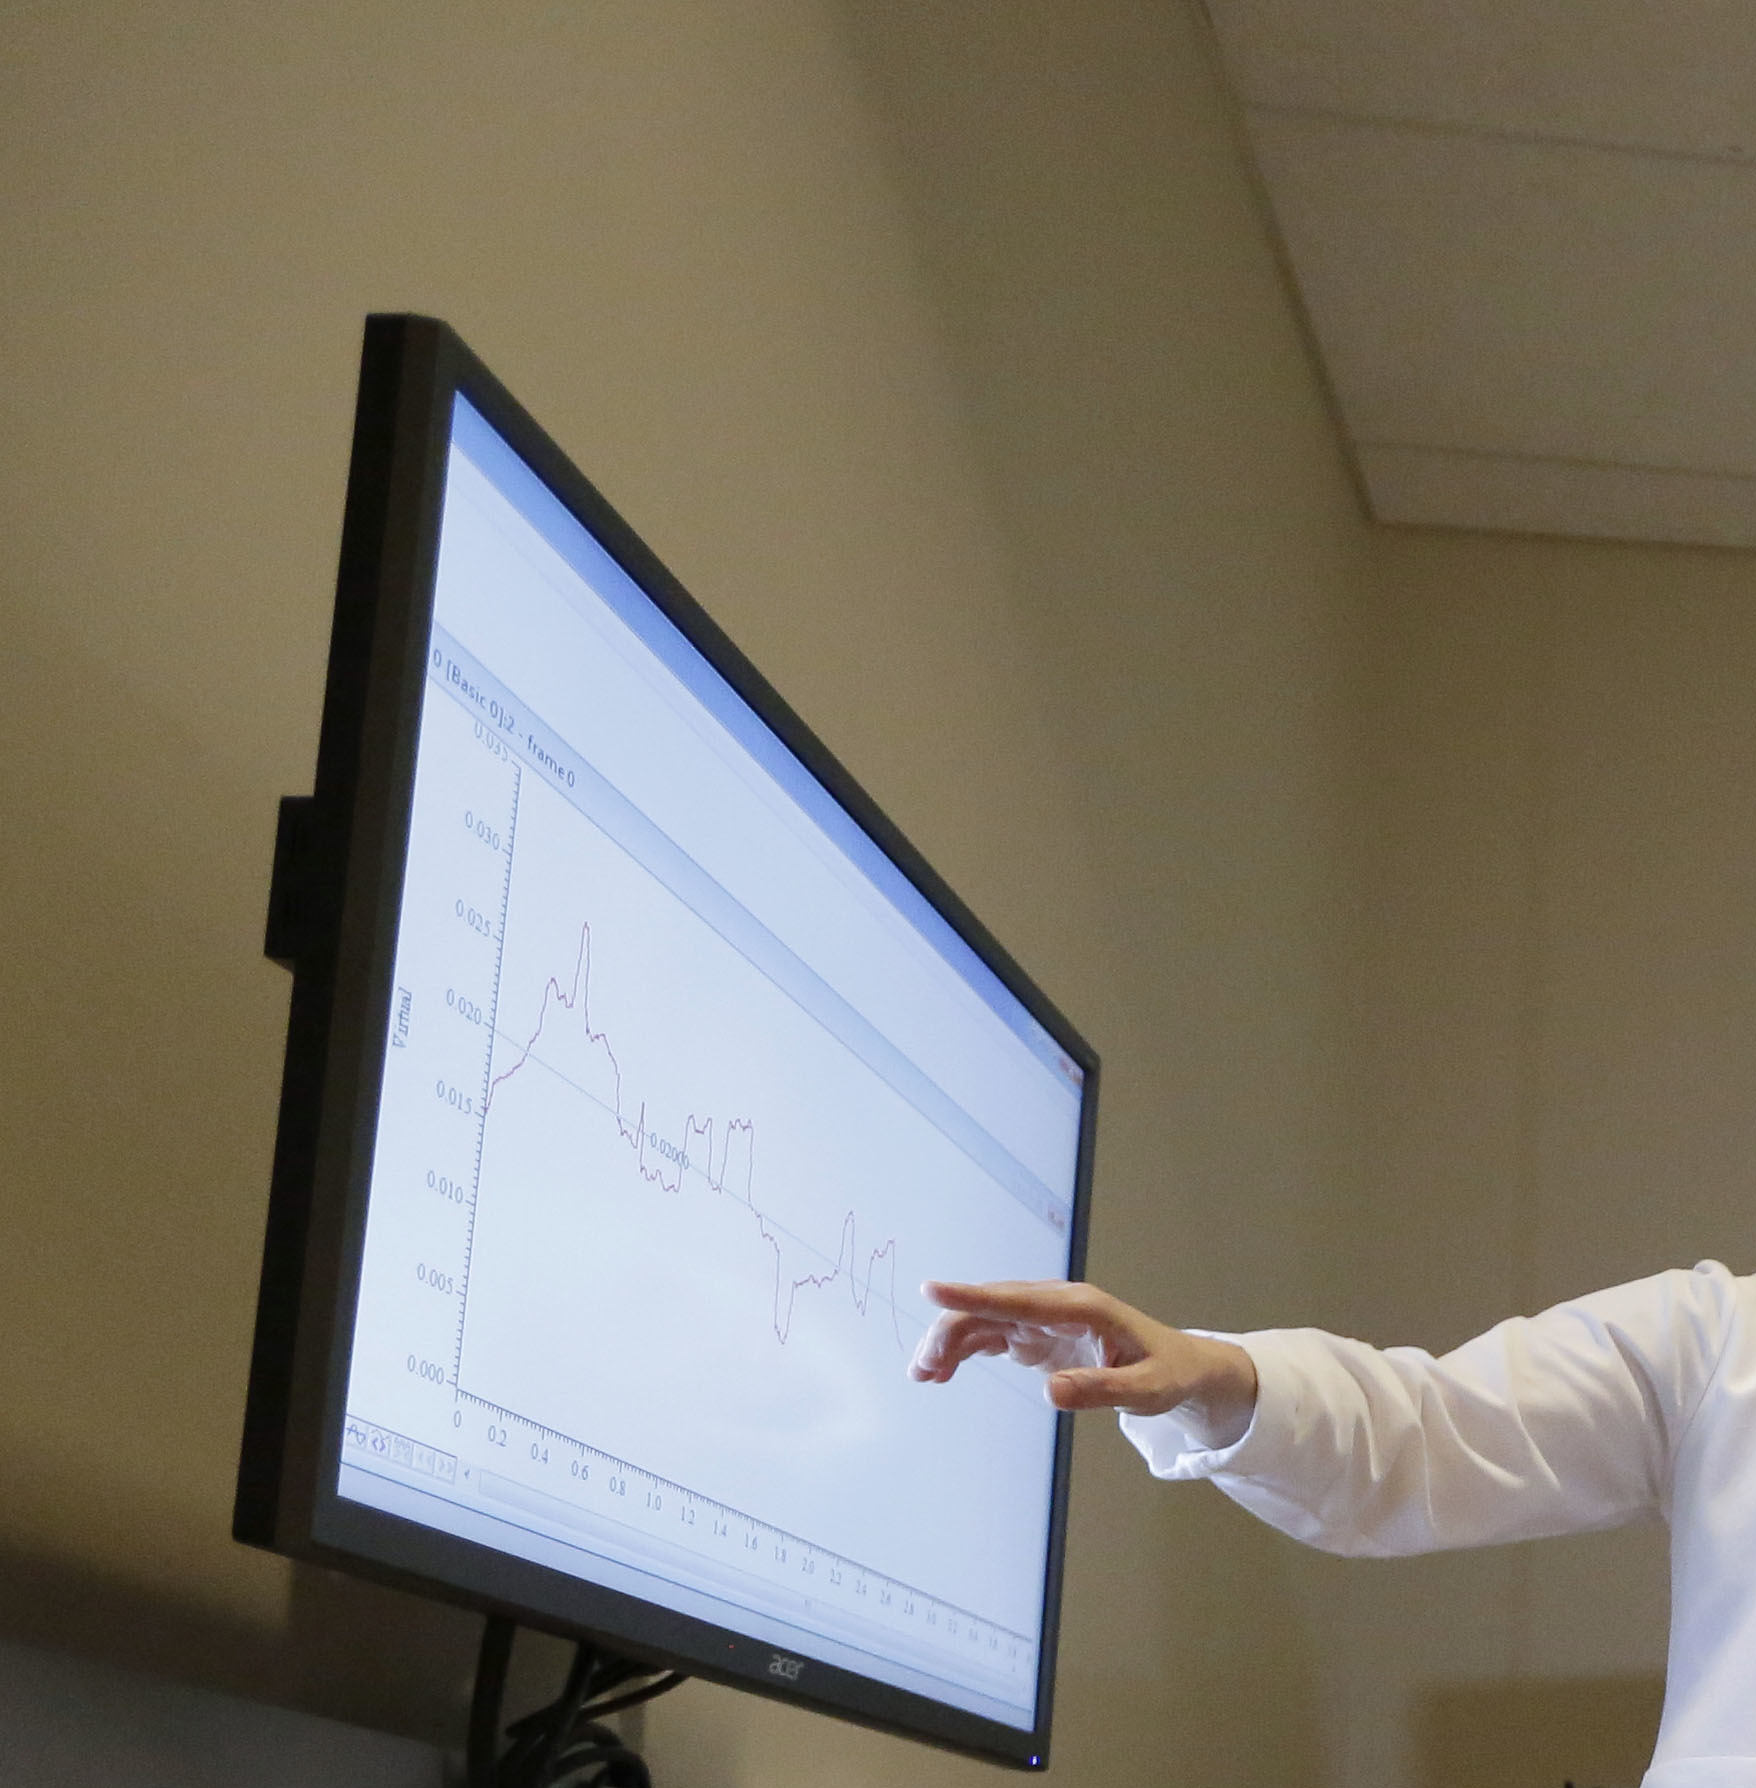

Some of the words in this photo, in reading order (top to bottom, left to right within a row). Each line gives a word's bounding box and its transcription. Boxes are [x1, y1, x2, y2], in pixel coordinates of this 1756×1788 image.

[446, 660, 486, 709] [Basic
[490, 700, 515, 735] 0]:2
[465, 811, 500, 850] 0.030
[455, 899, 491, 938] 0.025
[392, 986, 413, 1049] Virtual
[447, 988, 482, 1025] 0.020
[436, 1080, 472, 1115] 0.015
[427, 1170, 463, 1204] 0.010
[416, 1263, 453, 1294] 0.005
[407, 1354, 444, 1385] 0.000
[454, 1410, 462, 1428] 0
[487, 1425, 507, 1447] 0.2
[530, 1442, 549, 1465] 0.4
[571, 1460, 589, 1482] 0.6
[609, 1476, 626, 1497] 0.8
[646, 1491, 662, 1511] 1.0
[769, 1653, 804, 1680] acer
